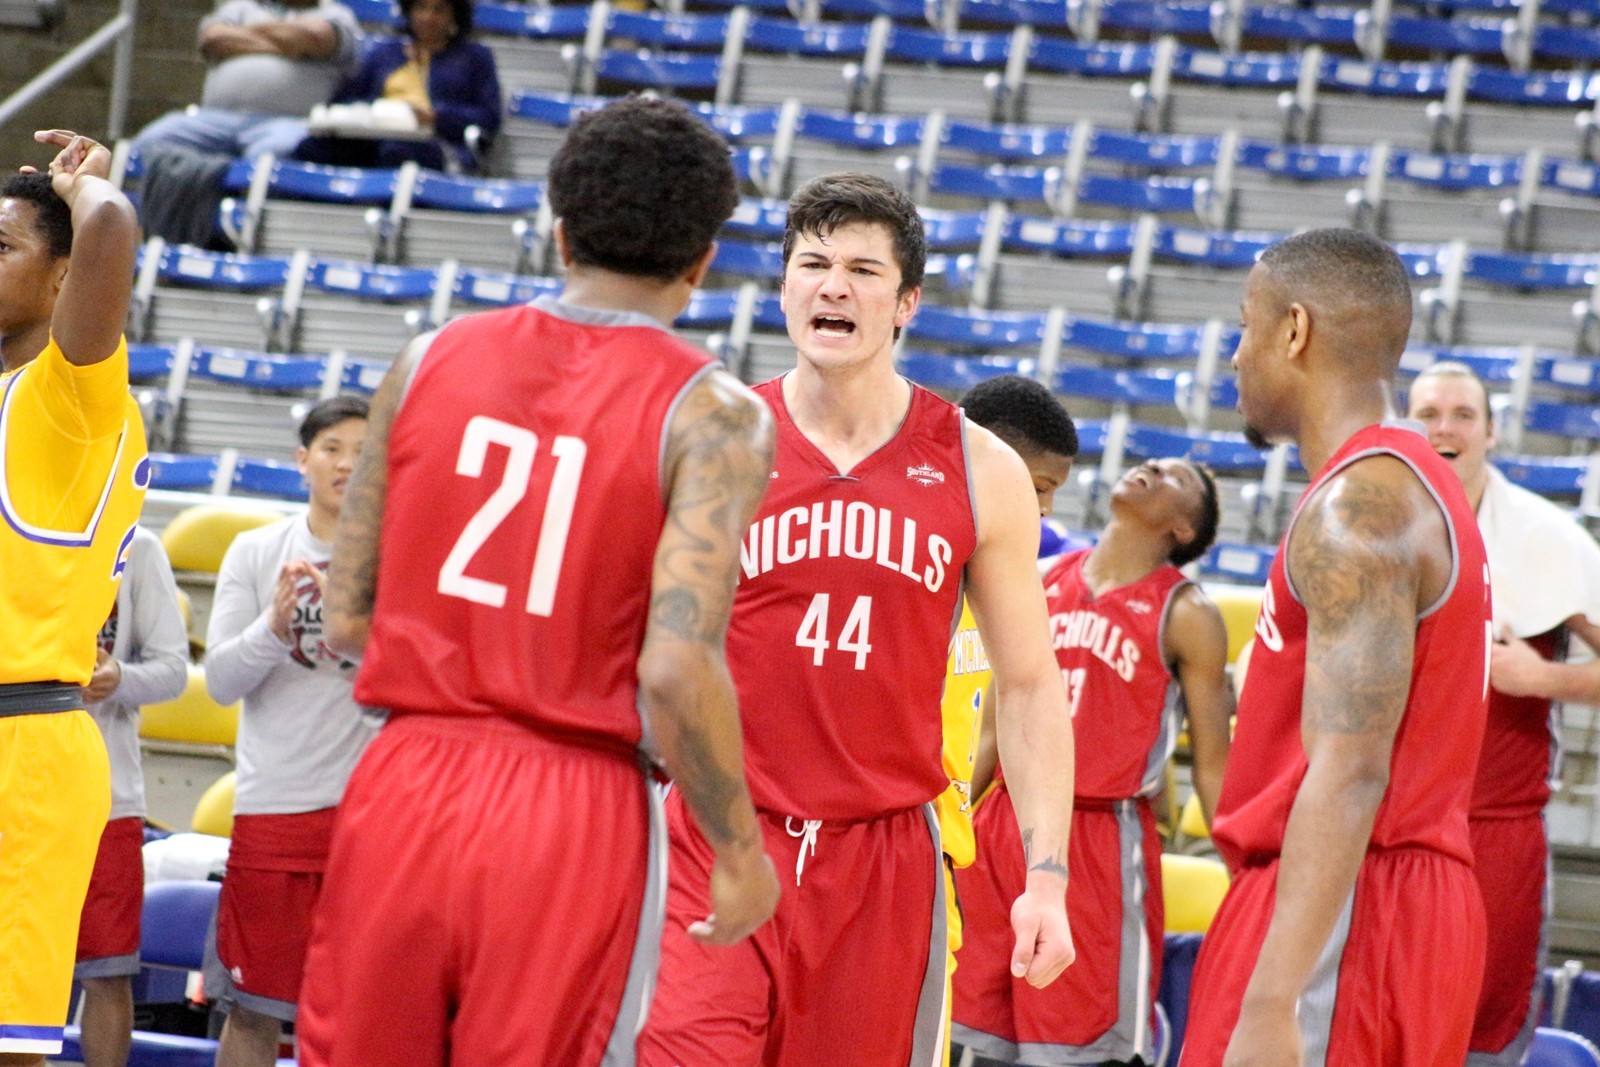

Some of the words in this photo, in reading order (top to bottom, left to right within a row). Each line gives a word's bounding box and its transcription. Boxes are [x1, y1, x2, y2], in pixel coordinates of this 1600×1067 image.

[906, 466, 945, 482] SOUTHLAND
[437, 415, 587, 618] 21
[736, 500, 952, 593] NICHOLLS
[795, 593, 873, 670] 44
[1049, 610, 1141, 683] CHOLLS
